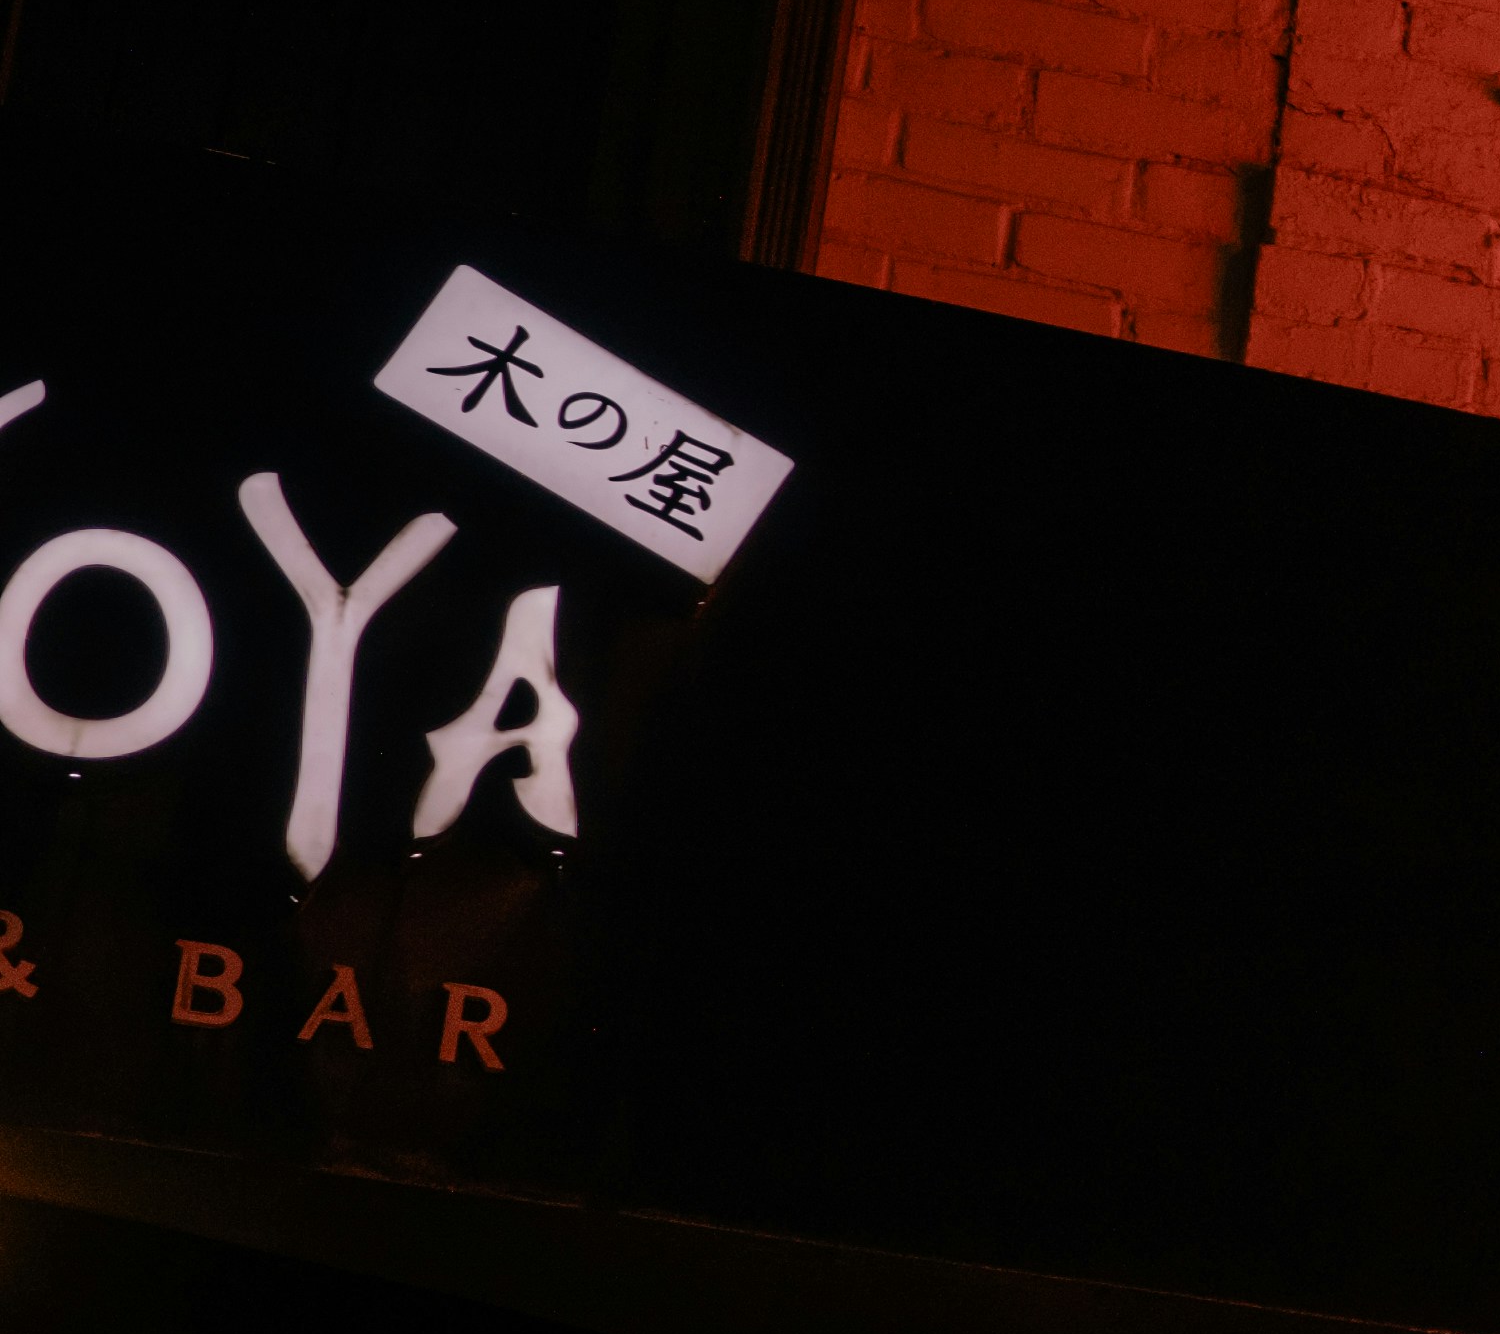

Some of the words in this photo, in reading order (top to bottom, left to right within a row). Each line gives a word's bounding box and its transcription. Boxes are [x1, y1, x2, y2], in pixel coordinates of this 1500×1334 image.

[425, 324, 736, 543] 木の屋
[0, 378, 580, 882] OYA
[169, 938, 506, 1072] BAR
